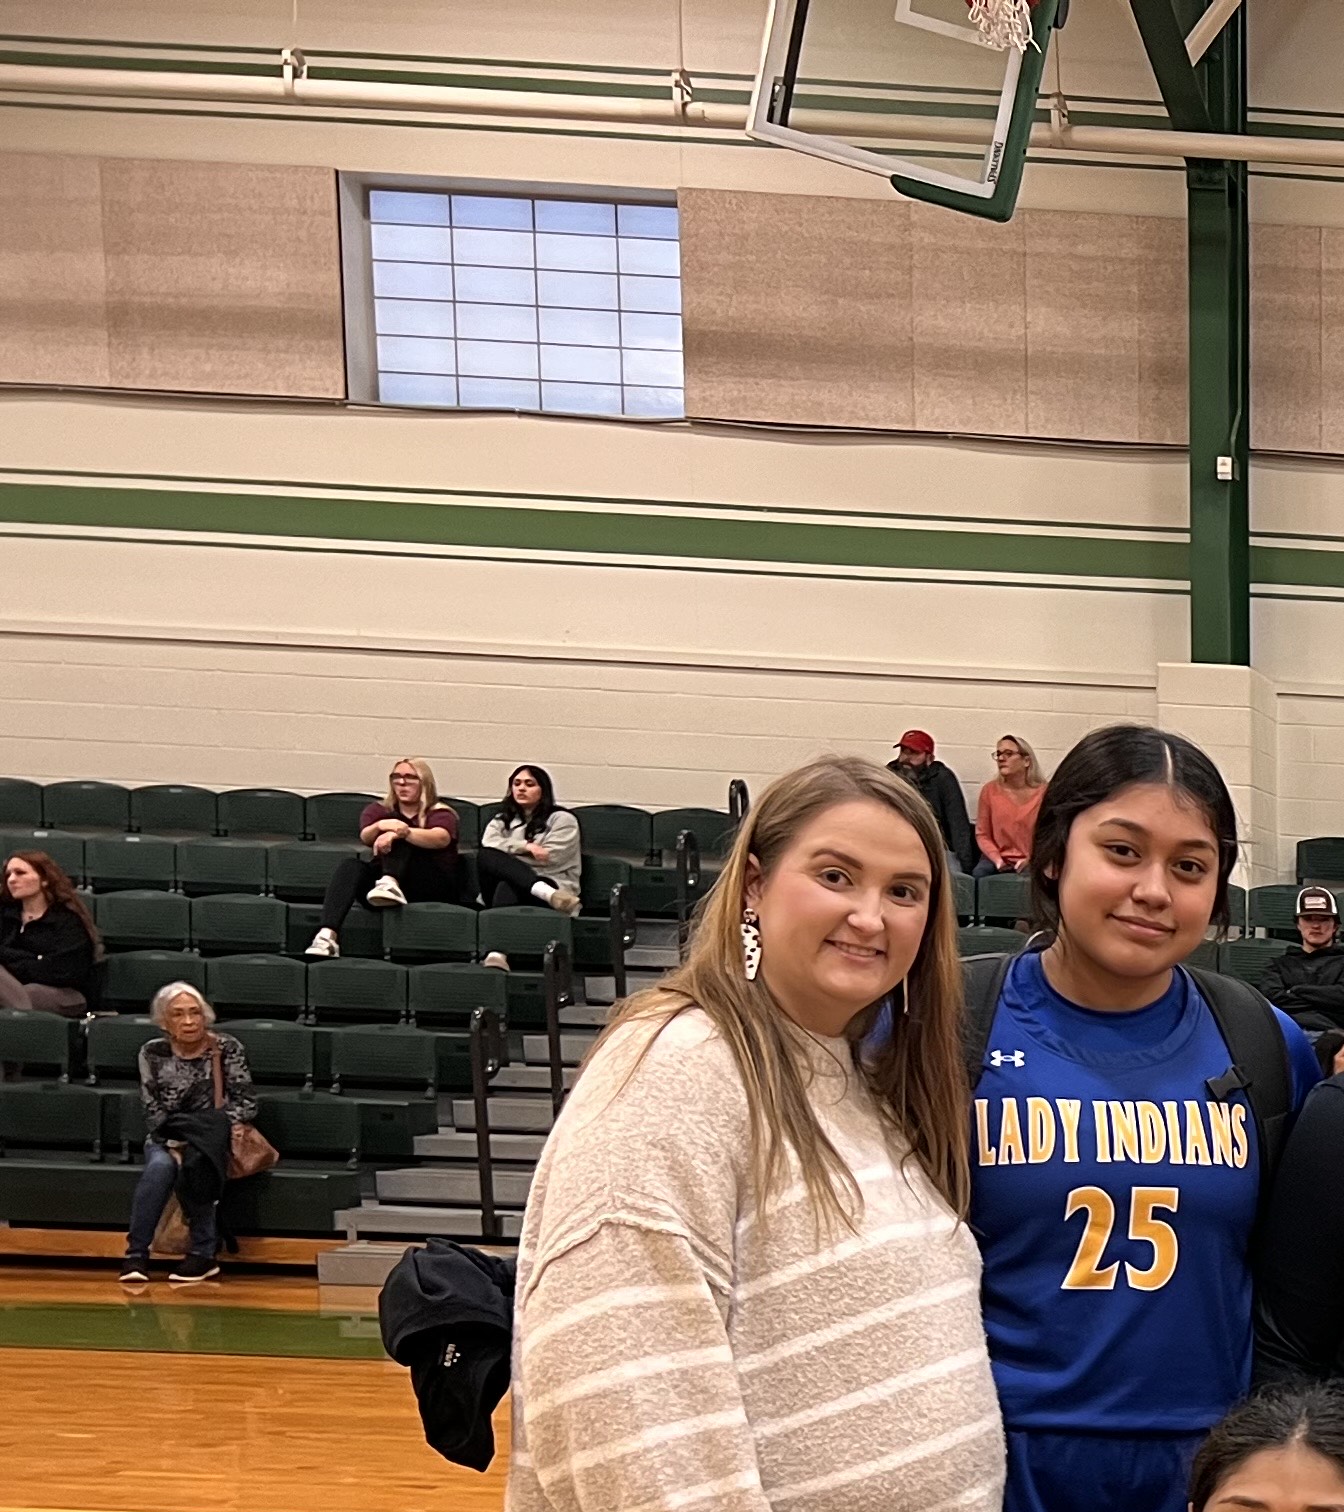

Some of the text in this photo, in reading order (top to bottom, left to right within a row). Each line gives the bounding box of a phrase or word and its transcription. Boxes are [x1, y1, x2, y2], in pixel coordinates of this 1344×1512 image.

[974, 1097, 1249, 1169] LADY INDIANS
[1060, 1186, 1180, 1291] 25
